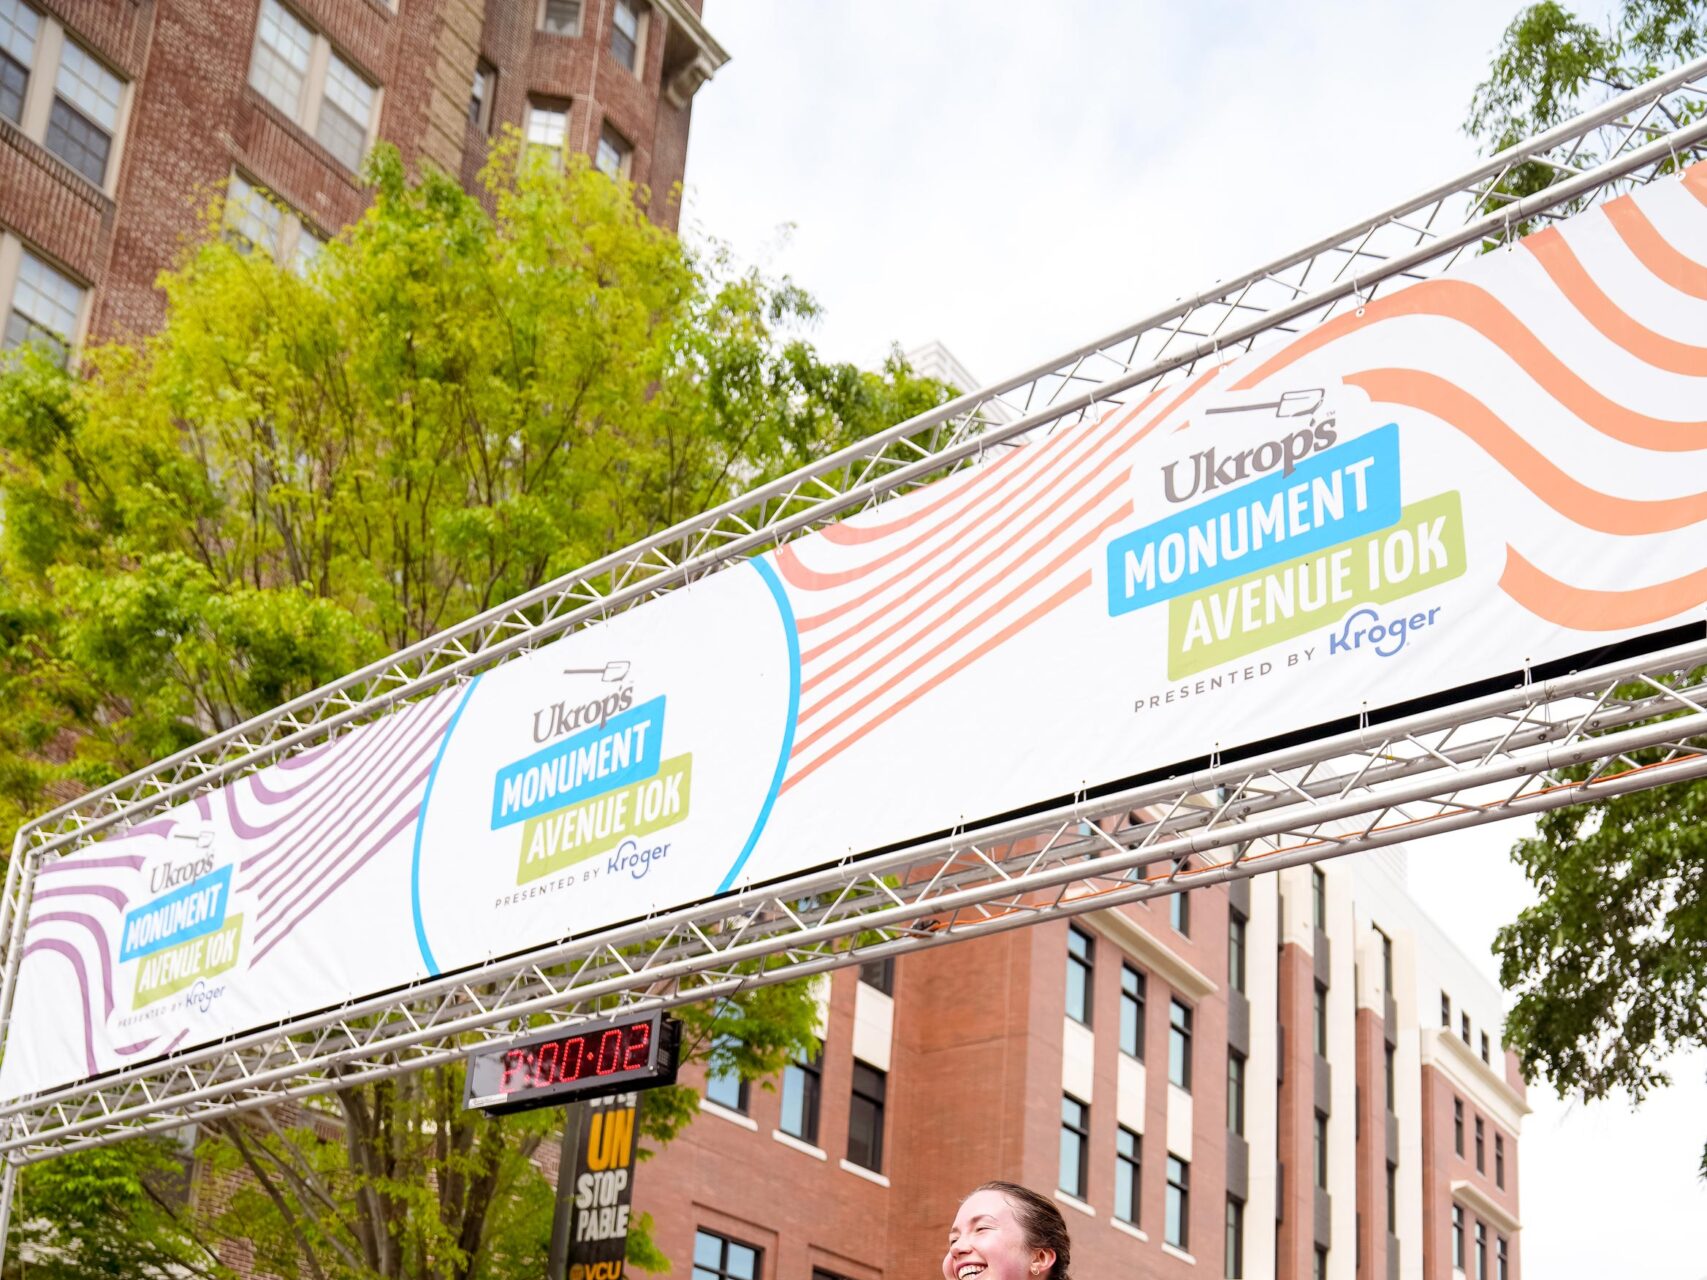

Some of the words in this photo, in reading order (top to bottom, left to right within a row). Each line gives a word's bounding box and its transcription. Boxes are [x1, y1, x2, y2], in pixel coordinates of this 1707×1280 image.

[1161, 417, 1338, 504] Ukrop's
[1124, 455, 1375, 599] MONUMENT
[1181, 548, 1353, 653] AVENUE
[1368, 515, 1449, 590] 10K
[1134, 661, 1273, 713] PRESENTED
[1287, 647, 1316, 667] BY
[1329, 606, 1441, 657] Kroger
[533, 685, 634, 743] Ukrop's
[501, 719, 651, 817] MONUMENT
[526, 790, 630, 864] AVENUE
[634, 771, 684, 827] 10K
[150, 850, 215, 894] Ukrop's
[495, 876, 575, 908] PRESENTED
[583, 869, 600, 882] BY
[607, 840, 671, 879] Kroger
[125, 883, 223, 953] MONUMENT
[138, 941, 205, 993] AVENUE
[186, 981, 226, 1013] Kroger
[587, 1107, 636, 1172] UN
[575, 1168, 628, 1209] STOP
[576, 1204, 630, 1242] PABLE
